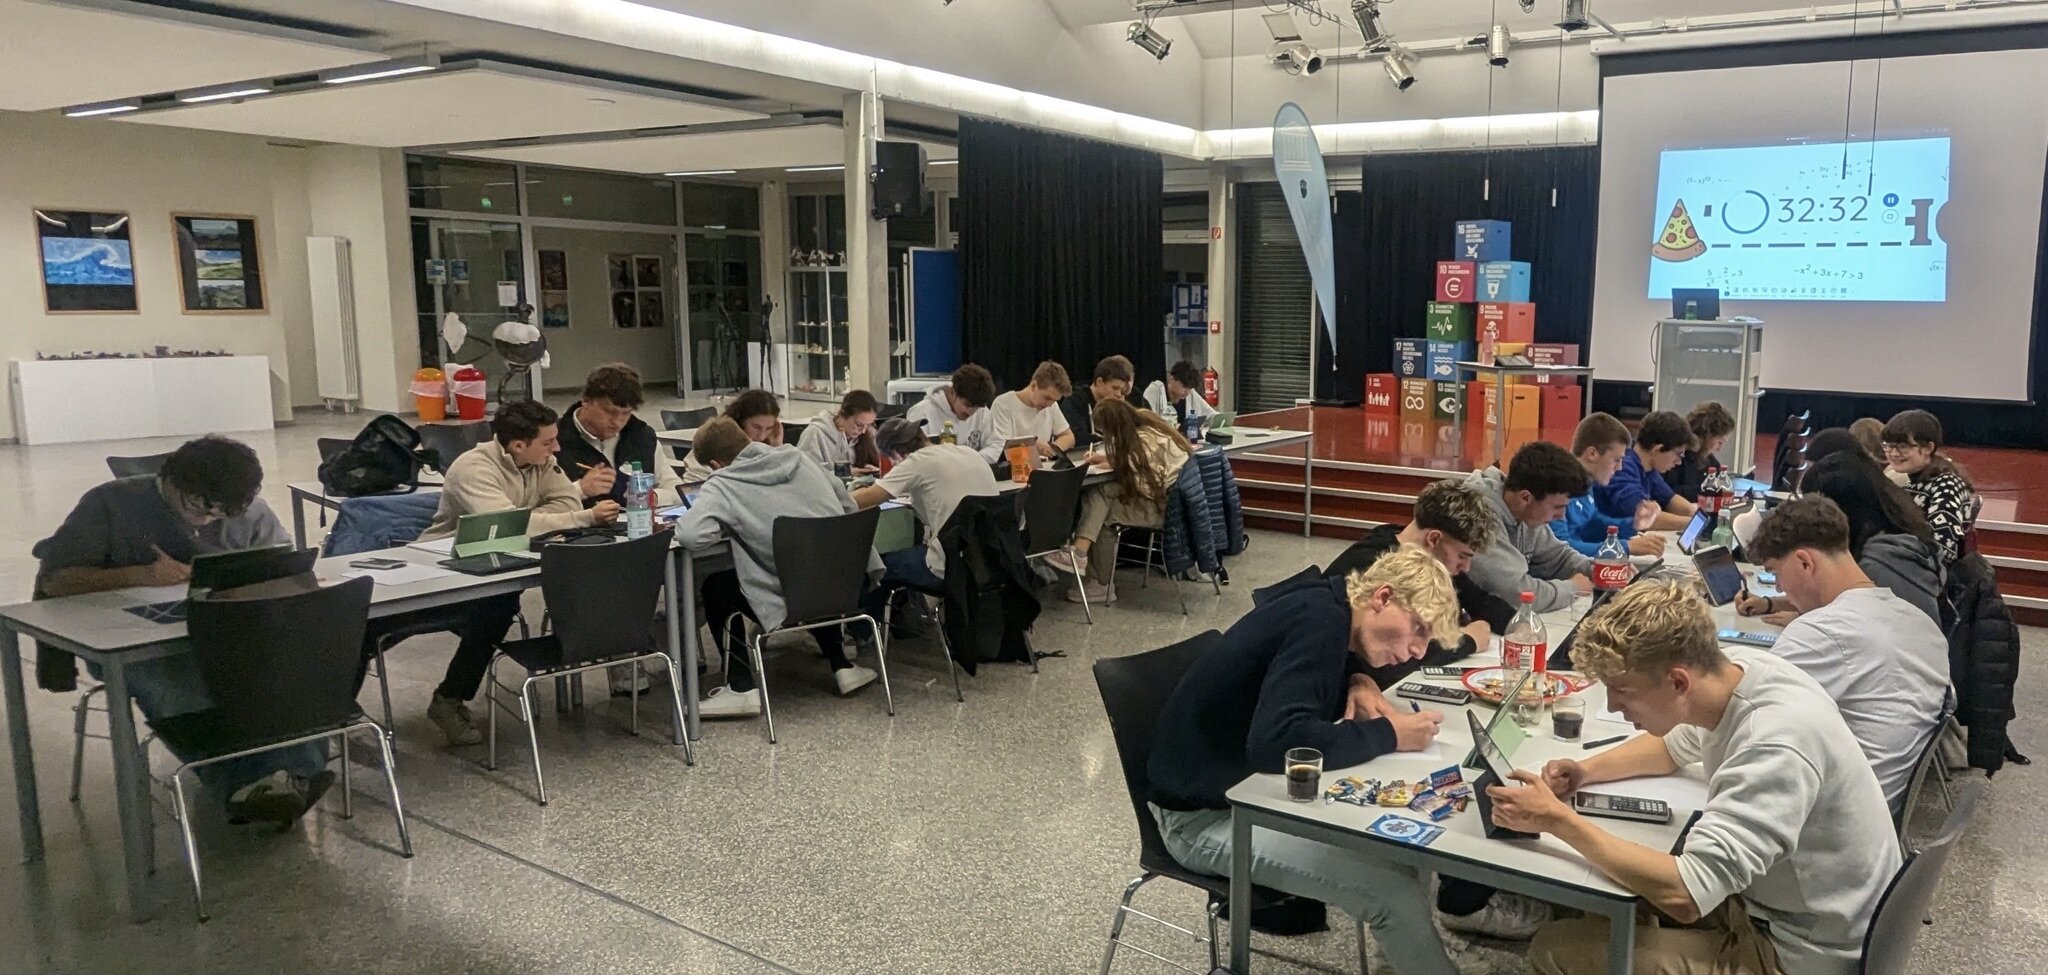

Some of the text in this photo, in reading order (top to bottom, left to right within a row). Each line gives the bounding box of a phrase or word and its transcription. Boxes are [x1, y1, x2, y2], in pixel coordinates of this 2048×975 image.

[1777, 195, 1868, 223] 32:32
[1457, 225, 1465, 234] 16
[1439, 265, 1447, 274] 10
[1429, 343, 1436, 353] 14
[1528, 347, 1533, 357] 8
[1403, 381, 1409, 390] 12
[1437, 383, 1444, 392] 13
